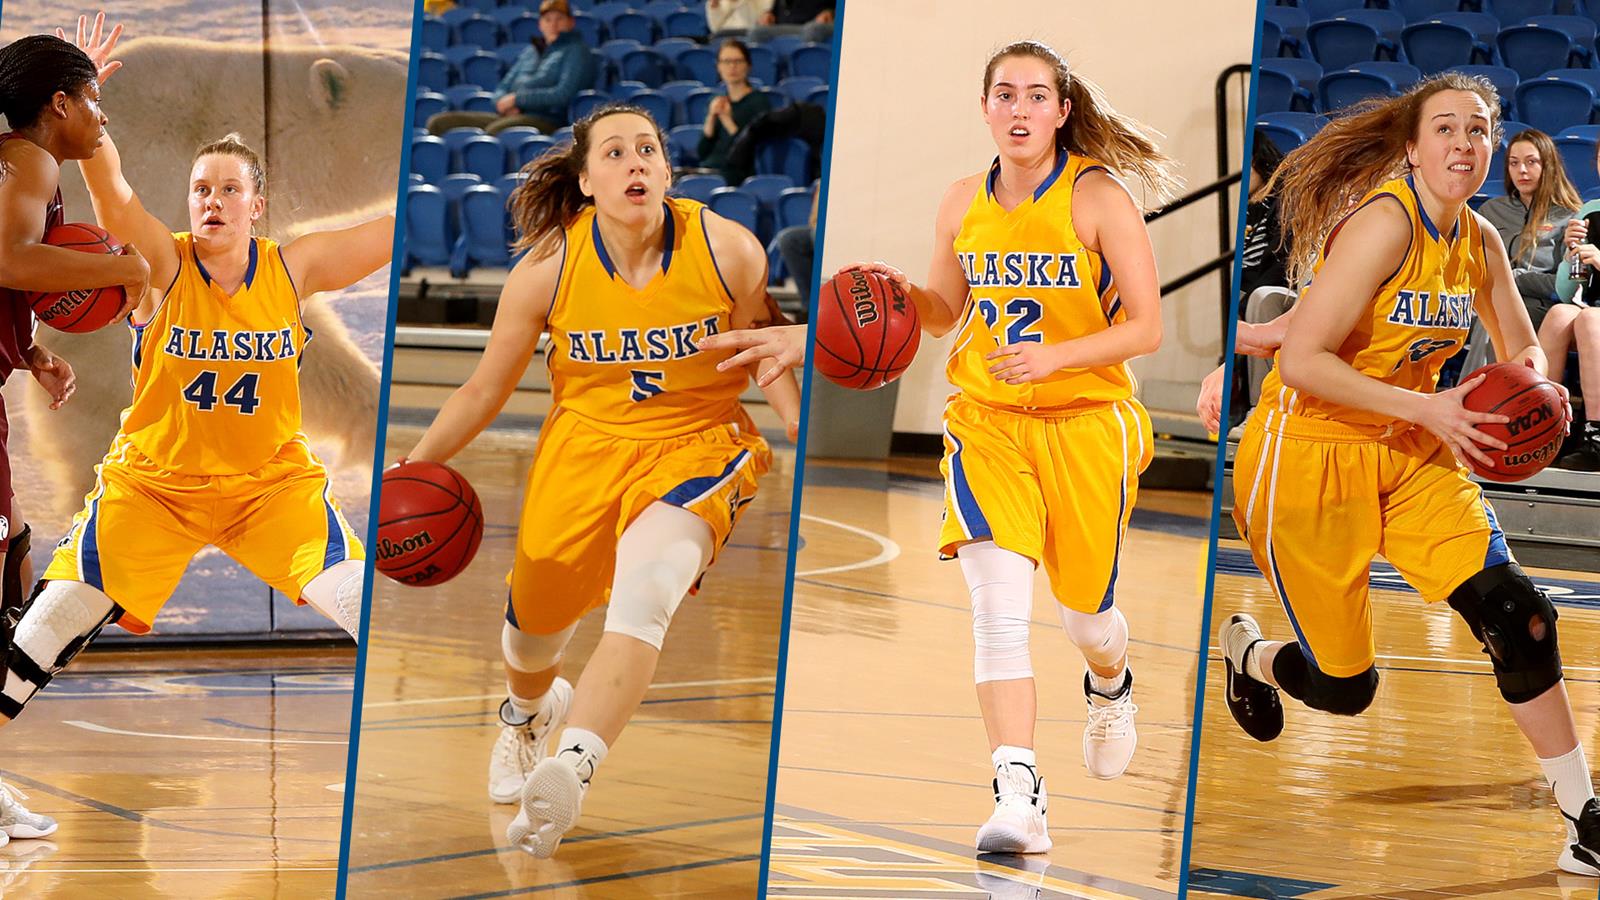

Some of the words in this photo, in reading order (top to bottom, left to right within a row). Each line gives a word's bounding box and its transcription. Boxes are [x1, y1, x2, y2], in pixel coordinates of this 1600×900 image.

[957, 252, 1081, 287] LASKA
[887, 278, 906, 316] NC
[1387, 290, 1471, 329] ALASK
[164, 325, 297, 361] ALASKA
[567, 315, 720, 364] ALASKA
[182, 370, 261, 415] 44
[630, 368, 666, 403] 5
[376, 530, 433, 560] ilson
